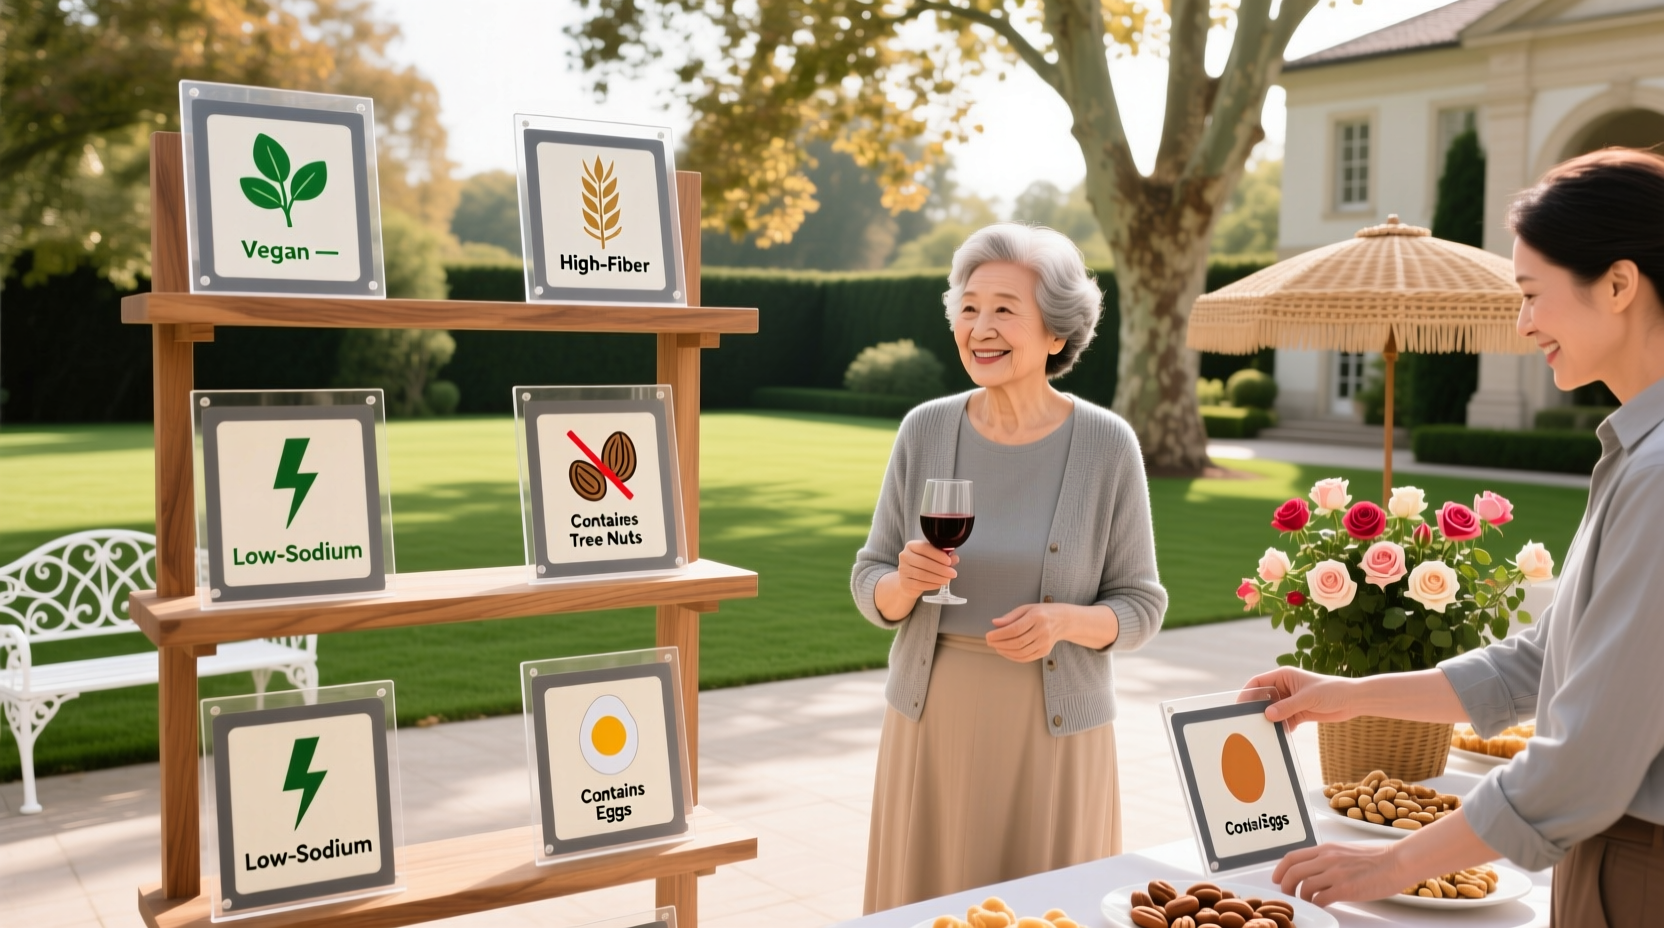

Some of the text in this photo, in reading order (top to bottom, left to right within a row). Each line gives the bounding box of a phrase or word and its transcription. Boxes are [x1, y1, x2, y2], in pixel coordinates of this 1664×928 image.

[241, 240, 309, 264] Vegan
[560, 253, 650, 275] High-Fiber
[569, 530, 643, 547] Tree Nuts
[233, 541, 363, 566] Low-Sodium
[581, 783, 645, 804] Contains
[596, 803, 632, 823] Eggs
[245, 838, 373, 871] Low-Sodium
